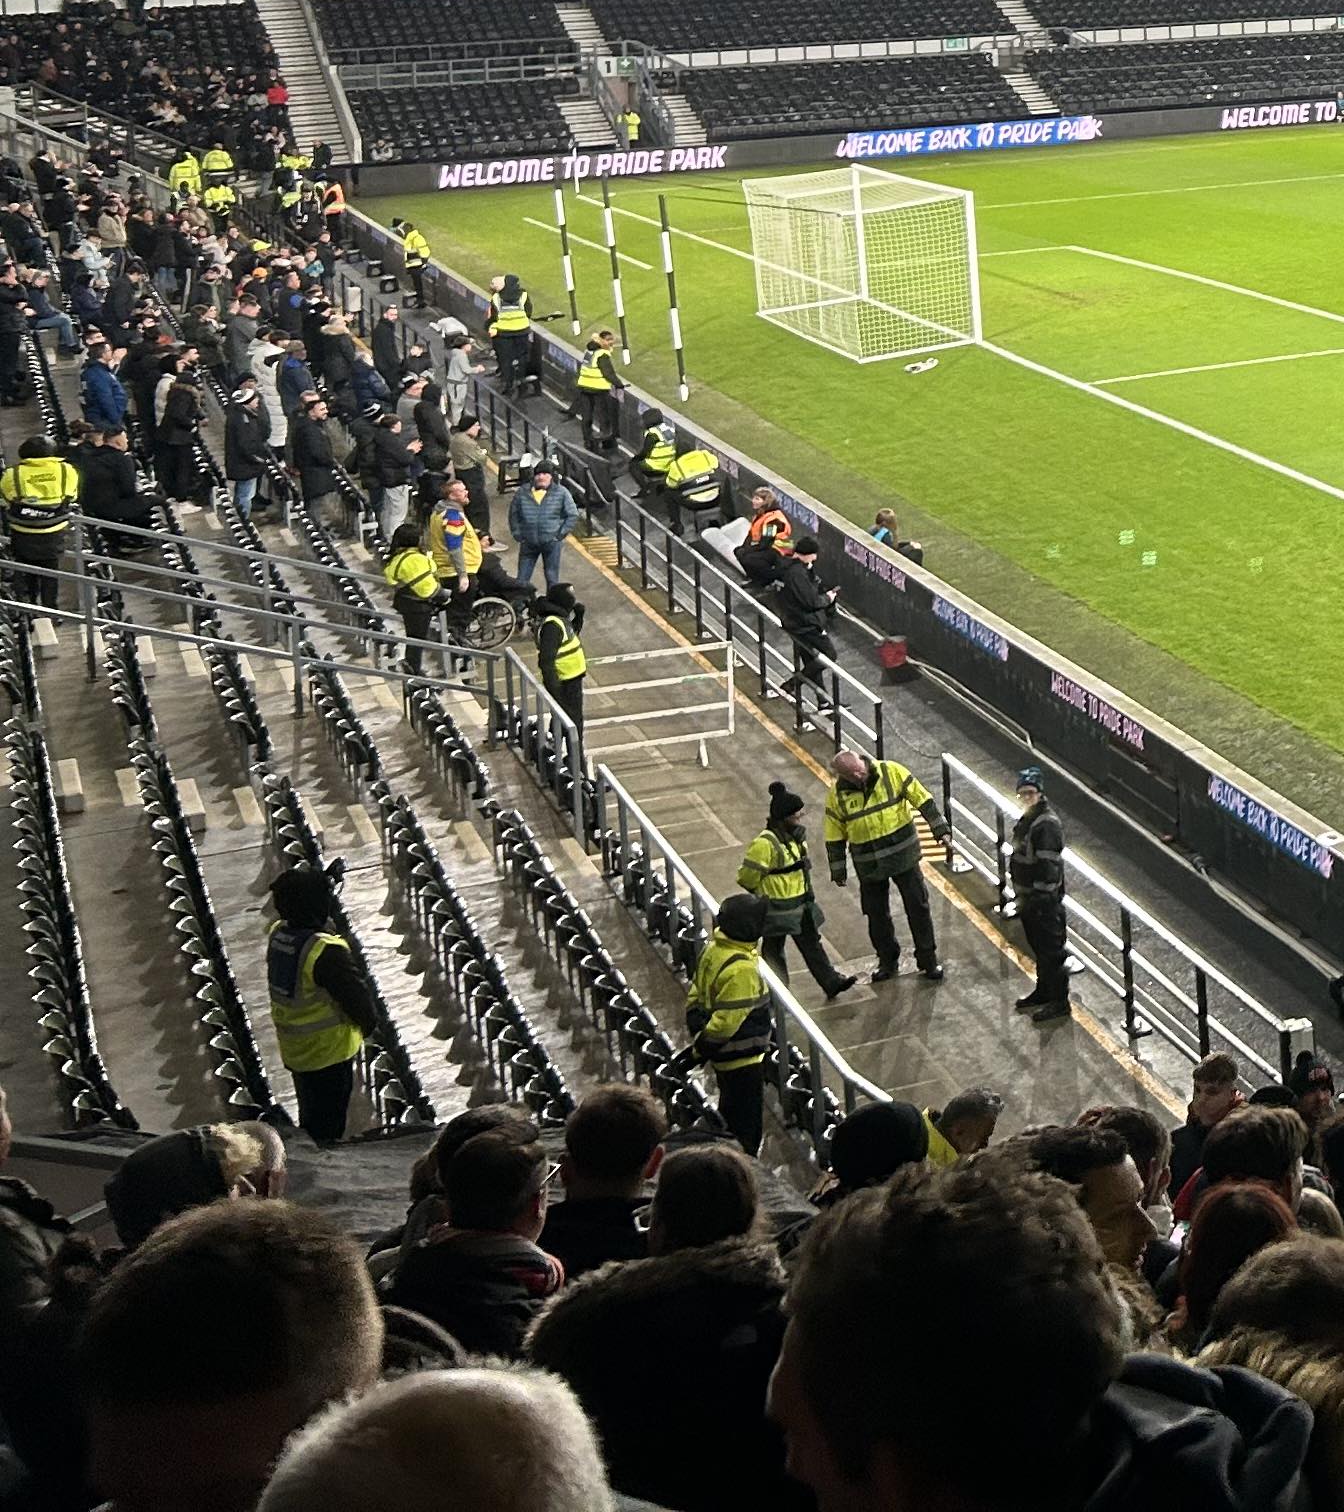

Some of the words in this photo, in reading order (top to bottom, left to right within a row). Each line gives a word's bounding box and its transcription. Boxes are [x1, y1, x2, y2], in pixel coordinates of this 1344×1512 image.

[605, 61, 611, 73] 1
[837, 131, 925, 158] WELCOME
[928, 128, 972, 150] BACK
[976, 122, 995, 147] TO
[998, 121, 1054, 145] PRIDE
[1058, 115, 1103, 140] PARK
[1221, 104, 1310, 129] WELCOME
[1315, 102, 1336, 121] TO
[440, 157, 555, 188] WELCOME
[561, 154, 591, 180] TO
[596, 149, 665, 177] PRIDE
[668, 146, 727, 170] PARK
[1051, 671, 1086, 712] WELCOME
[1088, 694, 1098, 719] TO
[1098, 702, 1121, 735] PRIDE
[1122, 717, 1145, 751] PARK
[1208, 774, 1246, 817] WELCOME
[1247, 800, 1267, 833] BACK
[1269, 809, 1280, 842] TO
[1280, 822, 1309, 862] PRIDE
[1310, 841, 1334, 879] PARK
